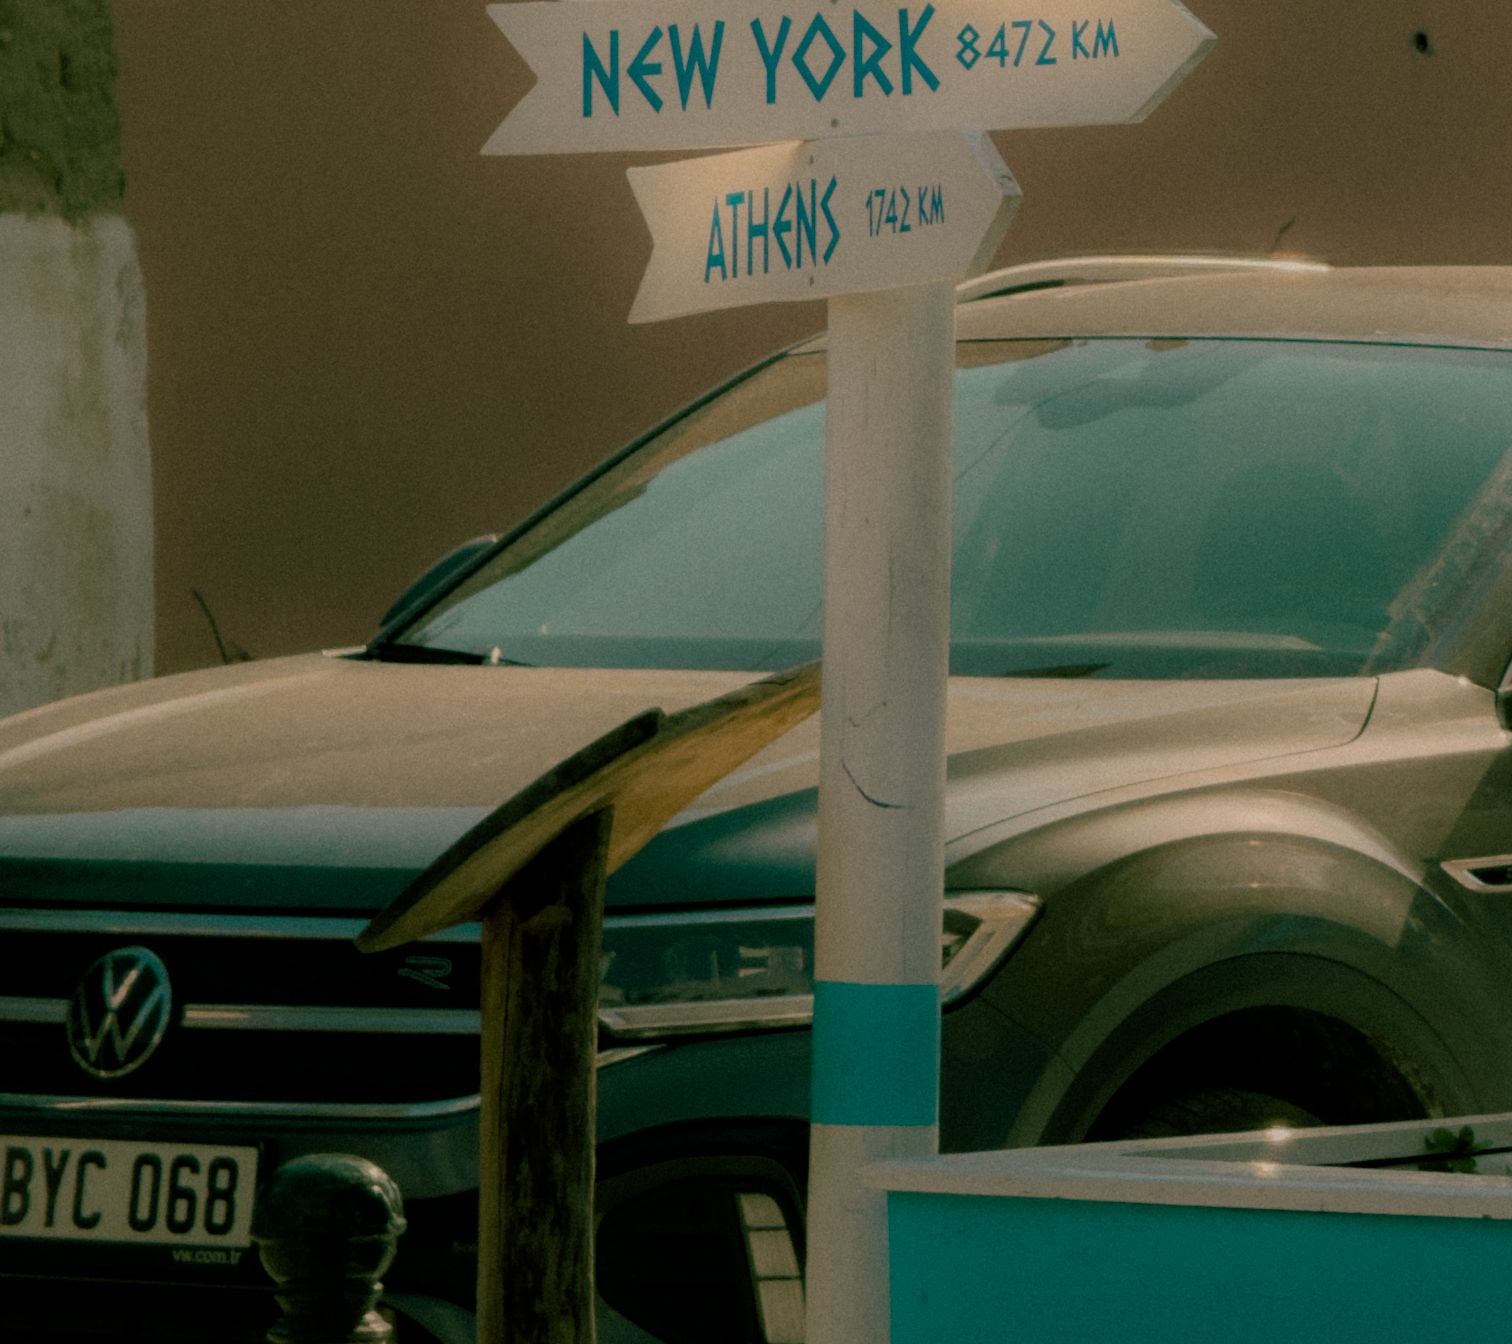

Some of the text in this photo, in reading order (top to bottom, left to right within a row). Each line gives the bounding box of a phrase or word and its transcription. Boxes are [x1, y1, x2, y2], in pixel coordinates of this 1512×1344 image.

[581, 2, 1121, 119] NEW YORK 8472 KM
[704, 175, 945, 284] ATHENS 1742 KM
[0, 1145, 240, 1236] BYC 068
[171, 1247, 242, 1265] vw.com.tr
